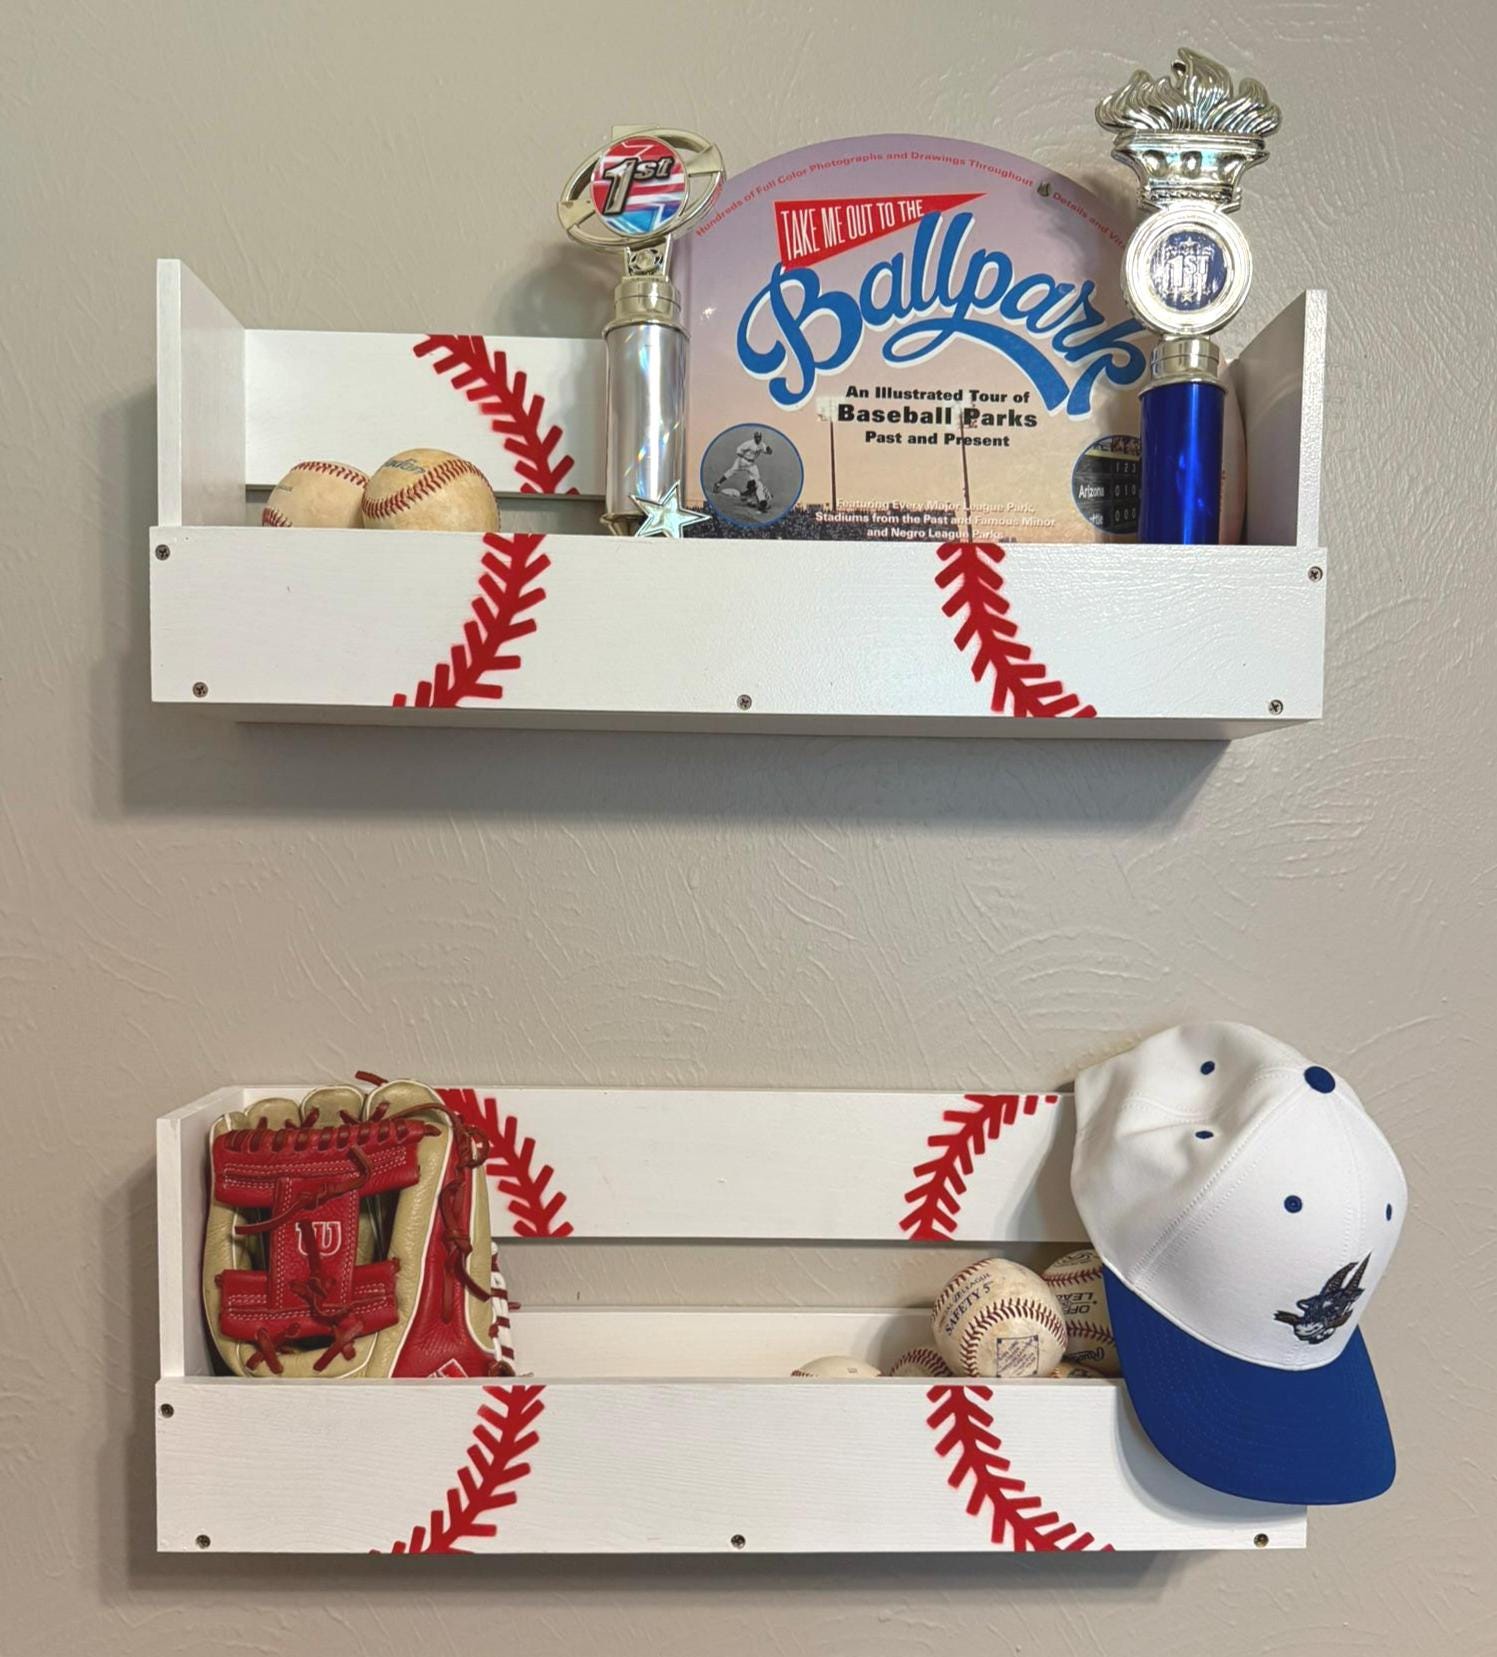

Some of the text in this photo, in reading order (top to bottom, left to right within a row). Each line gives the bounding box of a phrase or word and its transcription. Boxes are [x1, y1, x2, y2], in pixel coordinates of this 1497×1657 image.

[603, 157, 675, 216] 1st
[696, 198, 743, 237] Hundreds
[756, 180, 776, 194] Full
[777, 168, 807, 184] Color
[809, 152, 883, 172] Photographs
[886, 151, 909, 160] and
[911, 151, 966, 166] Drawings
[969, 159, 1034, 187] Throughout
[1053, 191, 1088, 219] Details
[1089, 216, 1110, 233] and
[781, 199, 925, 261] TAKE ME OUT TO THE
[736, 212, 1148, 421] Ballpark
[846, 386, 1031, 404] An Illustrated Tour of
[838, 404, 1039, 428] Baseball Parks
[865, 431, 1010, 447] Past and Present
[1078, 484, 1105, 499] Arizona
[815, 511, 1056, 527] Stadiums from the Past and Famous Minor
[836, 500, 889, 513] Featuring
[892, 500, 923, 512] Every
[926, 501, 960, 513] Major
[963, 502, 1004, 514] League
[867, 528, 889, 537] and
[891, 528, 925, 539] Negro
[928, 529, 968, 540] League
[945, 1288, 980, 1336] SAFETY
